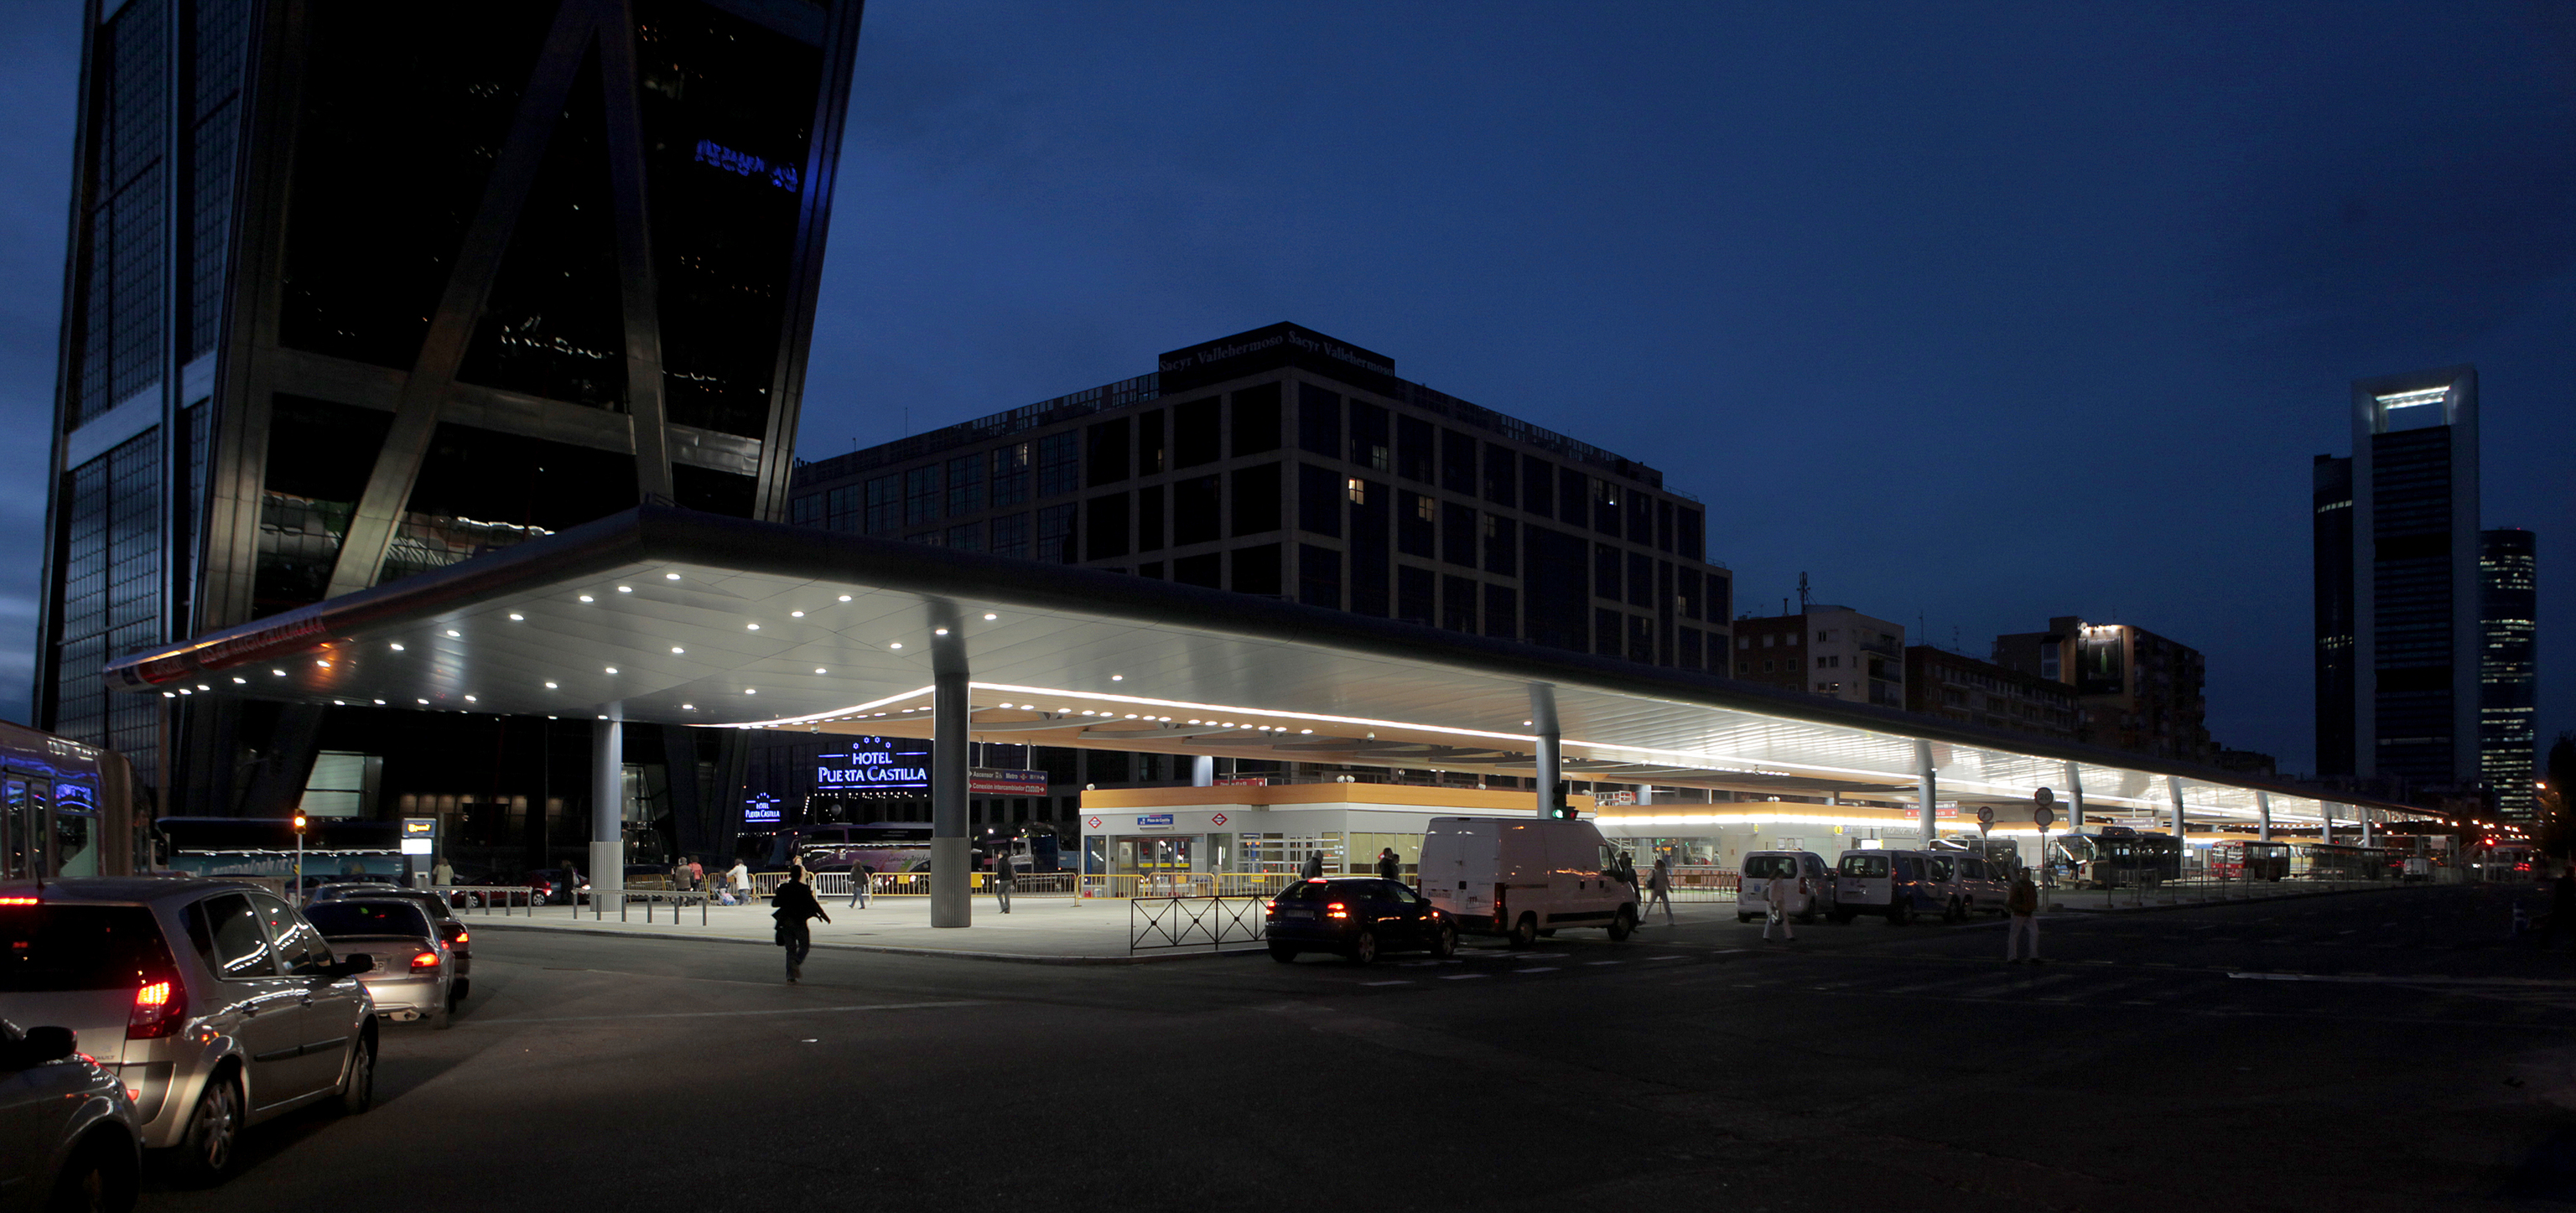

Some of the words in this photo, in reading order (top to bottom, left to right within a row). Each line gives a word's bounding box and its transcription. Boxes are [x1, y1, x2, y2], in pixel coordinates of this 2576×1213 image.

[1159, 355, 1193, 373] Sacyr
[1197, 334, 1284, 364] Vallehermoso
[1288, 329, 1320, 352] Sacyr
[1323, 340, 1394, 376] Vallehermoso
[852, 751, 893, 765] HOTEL
[818, 766, 865, 783] PUERTA
[866, 765, 927, 782] CASTILLA
